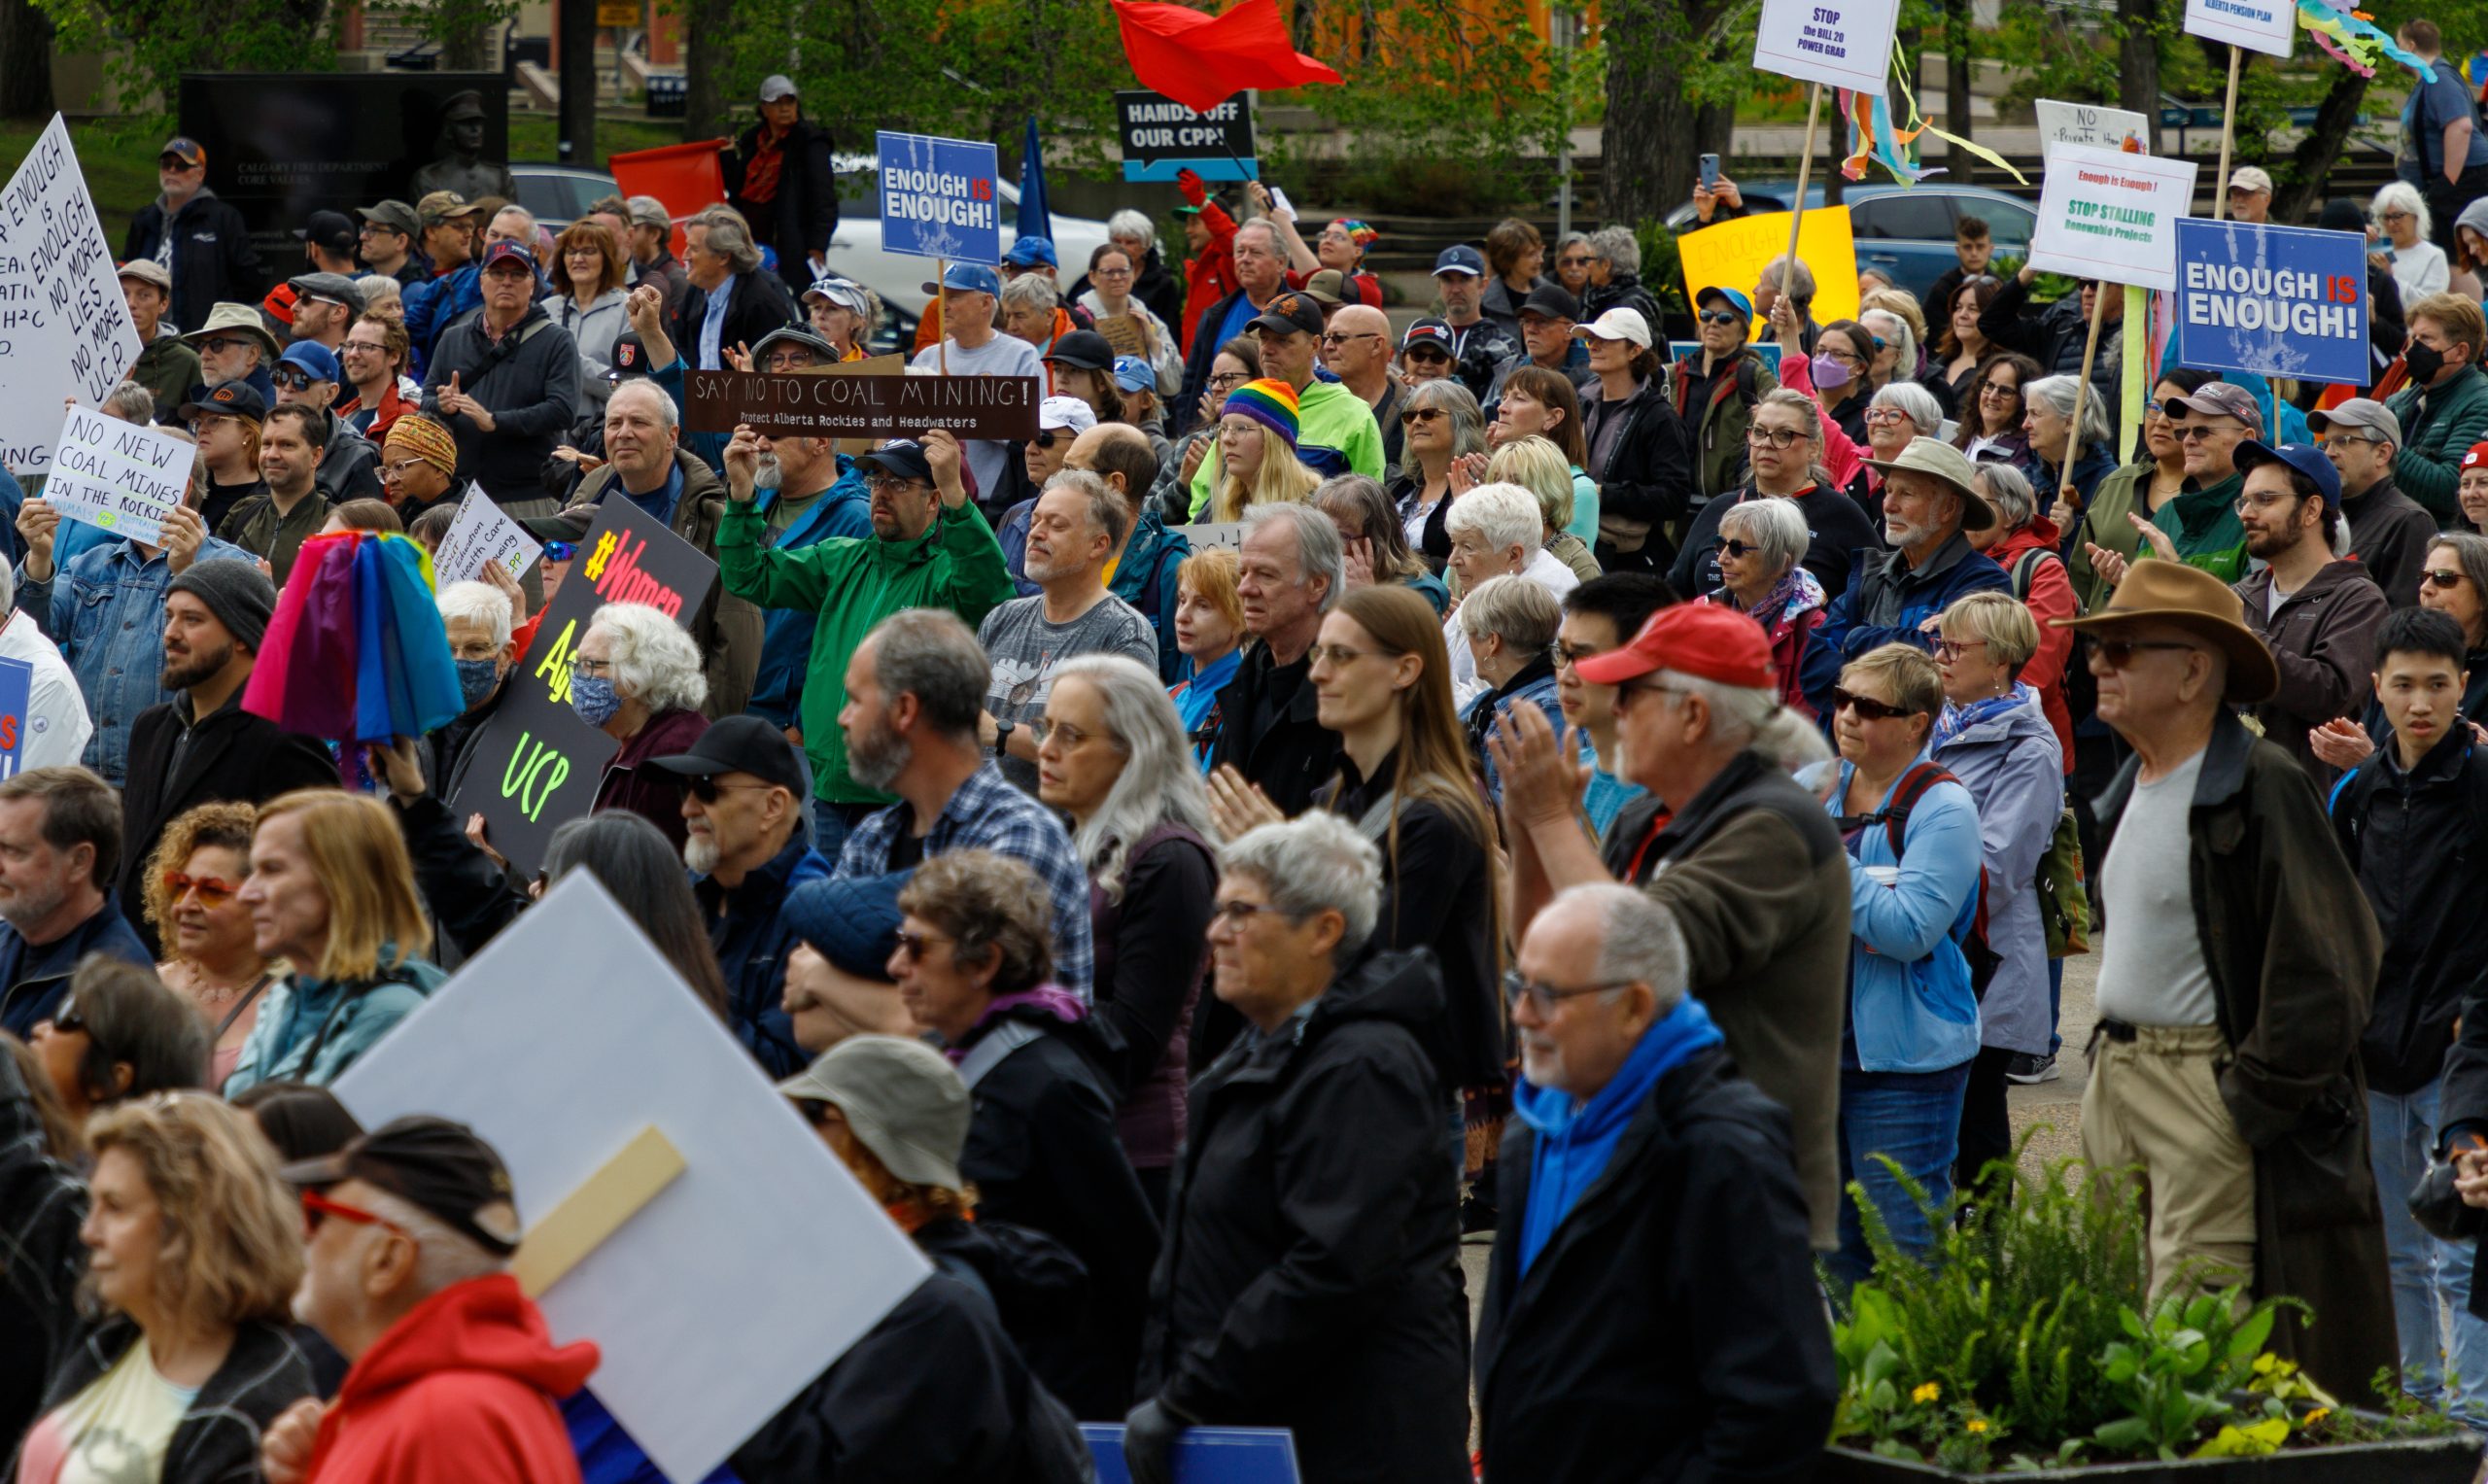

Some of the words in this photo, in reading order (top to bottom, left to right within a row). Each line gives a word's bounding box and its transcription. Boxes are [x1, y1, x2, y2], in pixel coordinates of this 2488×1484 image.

[1814, 7, 1840, 25] STOP
[2229, 4, 2255, 18] PENSION
[2257, 10, 2272, 22] PLAN
[1797, 38, 1823, 53] POWER
[1825, 44, 1846, 58] GRAB
[1803, 25, 1815, 37] the
[1817, 28, 1832, 41] BILL
[1834, 31, 1844, 43] 20
[1127, 104, 1197, 122] HANDS
[2077, 109, 2096, 126] NO
[1130, 128, 1175, 147] OUR
[1179, 127, 1225, 146] CPP!
[7, 132, 65, 227] ENOUGH
[238, 162, 290, 174] CALGARY
[292, 162, 314, 174] FIRE
[318, 162, 389, 174] DEPARTMENT
[238, 175, 265, 186] CORE
[270, 175, 311, 186] VALUES
[884, 167, 967, 198] ENOUGH
[972, 178, 991, 201] IS
[2078, 170, 2110, 186] Enough
[2111, 175, 2119, 186] is
[2120, 177, 2152, 191] Enough
[41, 201, 52, 224] IS
[886, 191, 992, 230] ENOUGH!
[2068, 199, 2098, 217] STOP
[2100, 204, 2156, 226] STALLING
[30, 187, 88, 285] ENOUGH
[1698, 227, 1780, 273] ENOUGH
[2114, 229, 2153, 243] Projects
[49, 277, 68, 316] NO
[68, 226, 102, 289] MORE
[2186, 261, 2319, 300] ENOUGH
[2327, 275, 2358, 304] IS
[67, 278, 102, 336] LIES
[2188, 293, 2358, 340] ENOUGH!
[71, 345, 91, 383] NO
[91, 300, 123, 351] MORE
[696, 375, 733, 401] SAY
[745, 377, 766, 401] NO
[772, 378, 802, 404] TO
[813, 379, 884, 405] COAL
[900, 378, 1028, 406] MINING!
[741, 411, 770, 424] Protect
[774, 413, 814, 426] Alberta
[819, 415, 866, 428] Rockies
[872, 415, 892, 428] and
[899, 416, 977, 429] Headwaters
[70, 415, 104, 446] NO
[113, 431, 174, 468] NEW
[50, 477, 73, 497] IN
[83, 487, 111, 506] THE
[59, 446, 108, 480] COAL
[116, 468, 181, 506] MINES
[456, 488, 476, 525] CARES
[456, 521, 484, 569] Education
[460, 546, 486, 581] Health
[485, 518, 506, 542] Care
[0, 714, 17, 751] S
[501, 731, 570, 824] UCP
